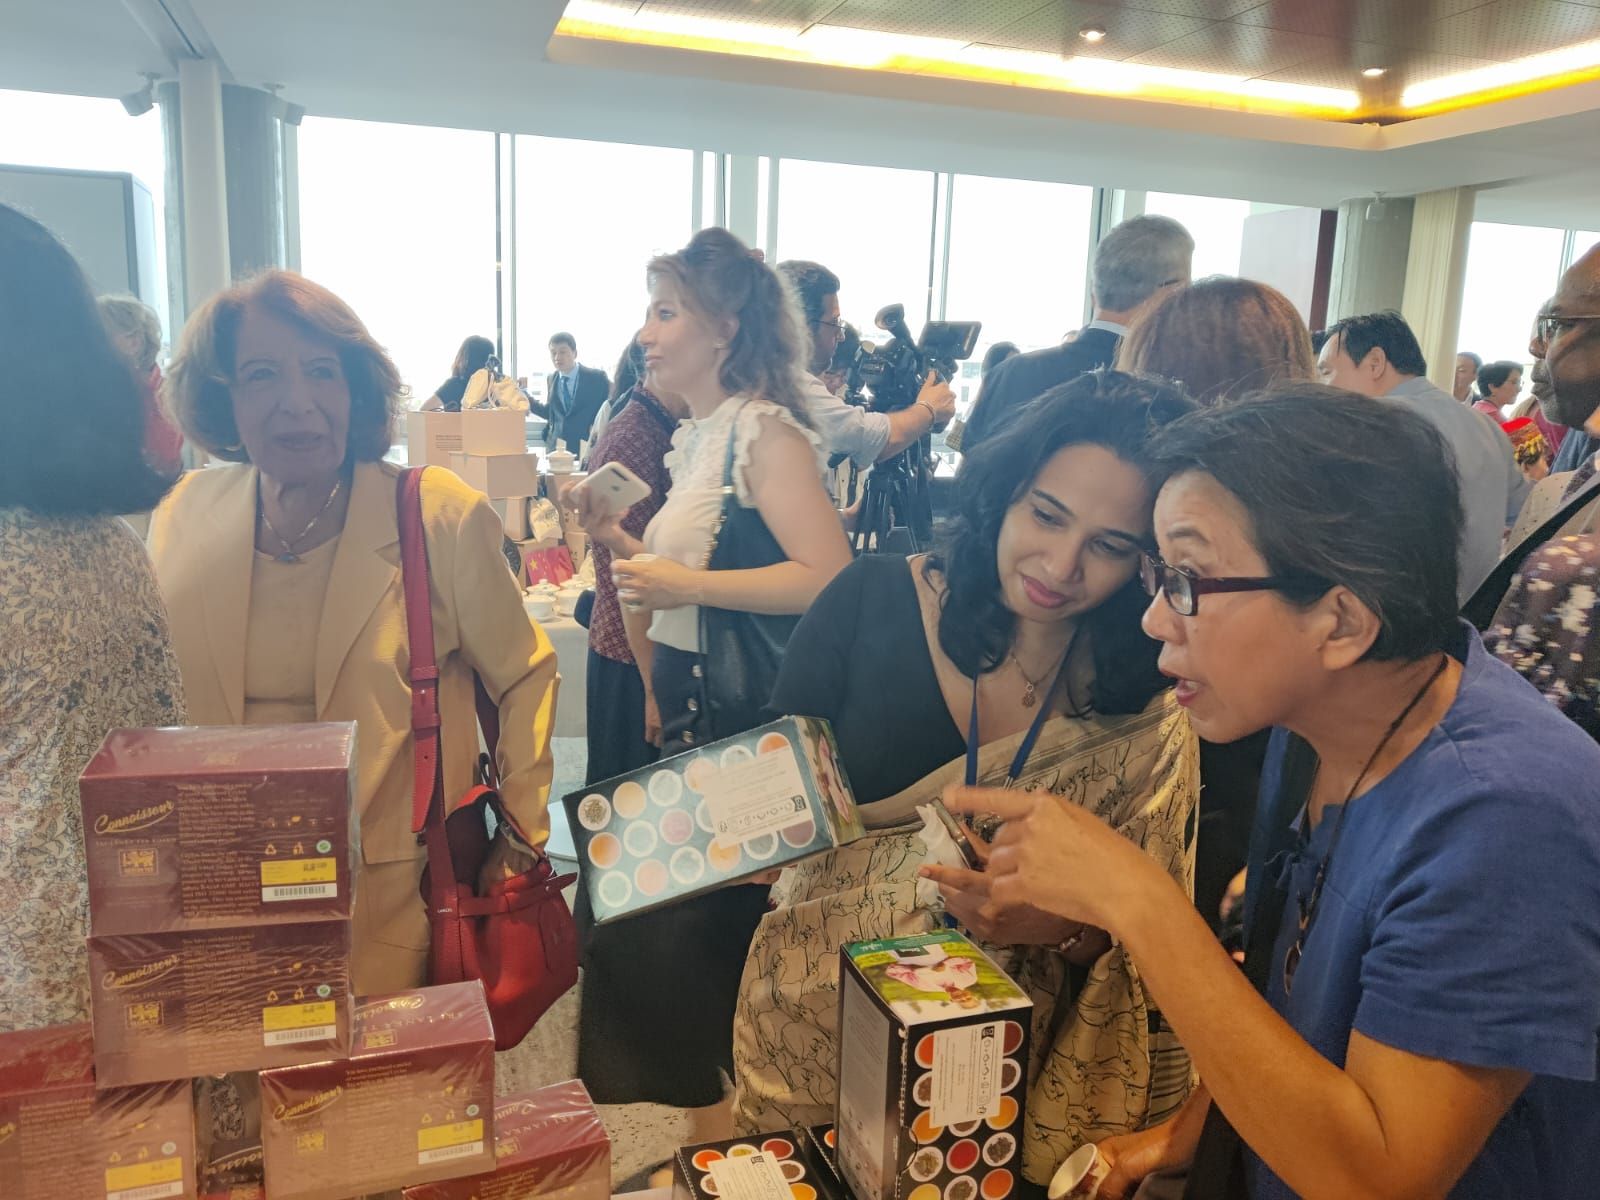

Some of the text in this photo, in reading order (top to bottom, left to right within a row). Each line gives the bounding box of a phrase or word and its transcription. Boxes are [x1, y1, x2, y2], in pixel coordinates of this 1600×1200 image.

[95, 800, 175, 833] Connoisseur
[102, 953, 180, 990] Connoisseur
[273, 1086, 343, 1121] Connoisseur
